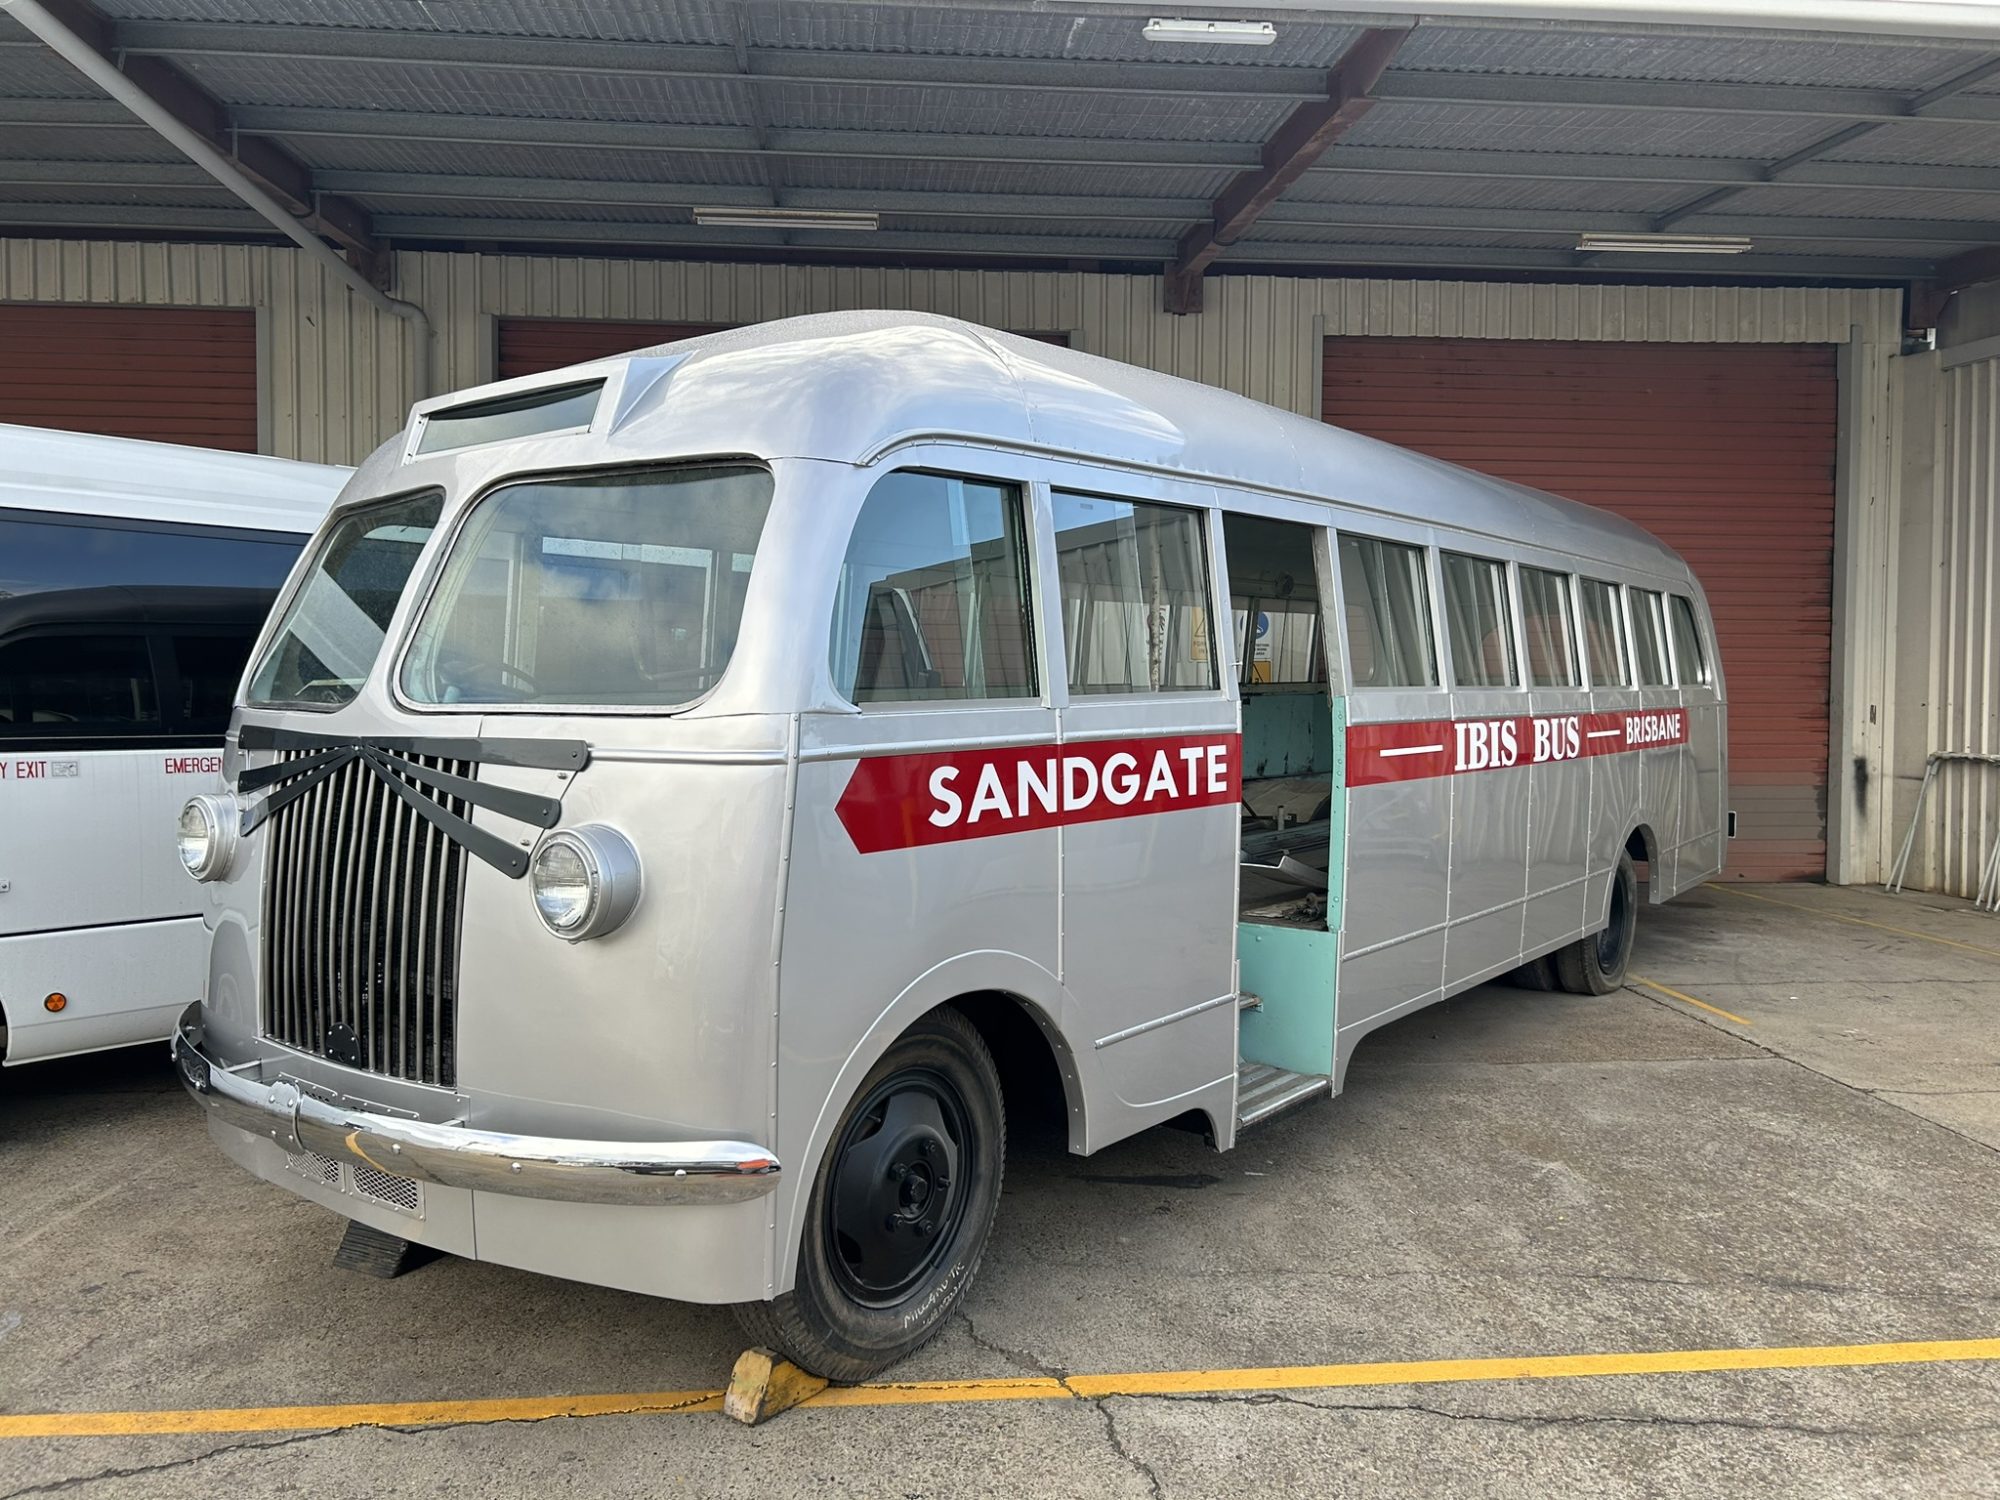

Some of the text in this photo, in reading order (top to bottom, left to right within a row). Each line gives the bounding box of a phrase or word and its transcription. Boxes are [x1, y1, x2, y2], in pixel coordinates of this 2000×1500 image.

[16, 761, 47, 779] EXIT
[928, 713, 1681, 828] SANDGATE IBIS BUS BRISBANE
